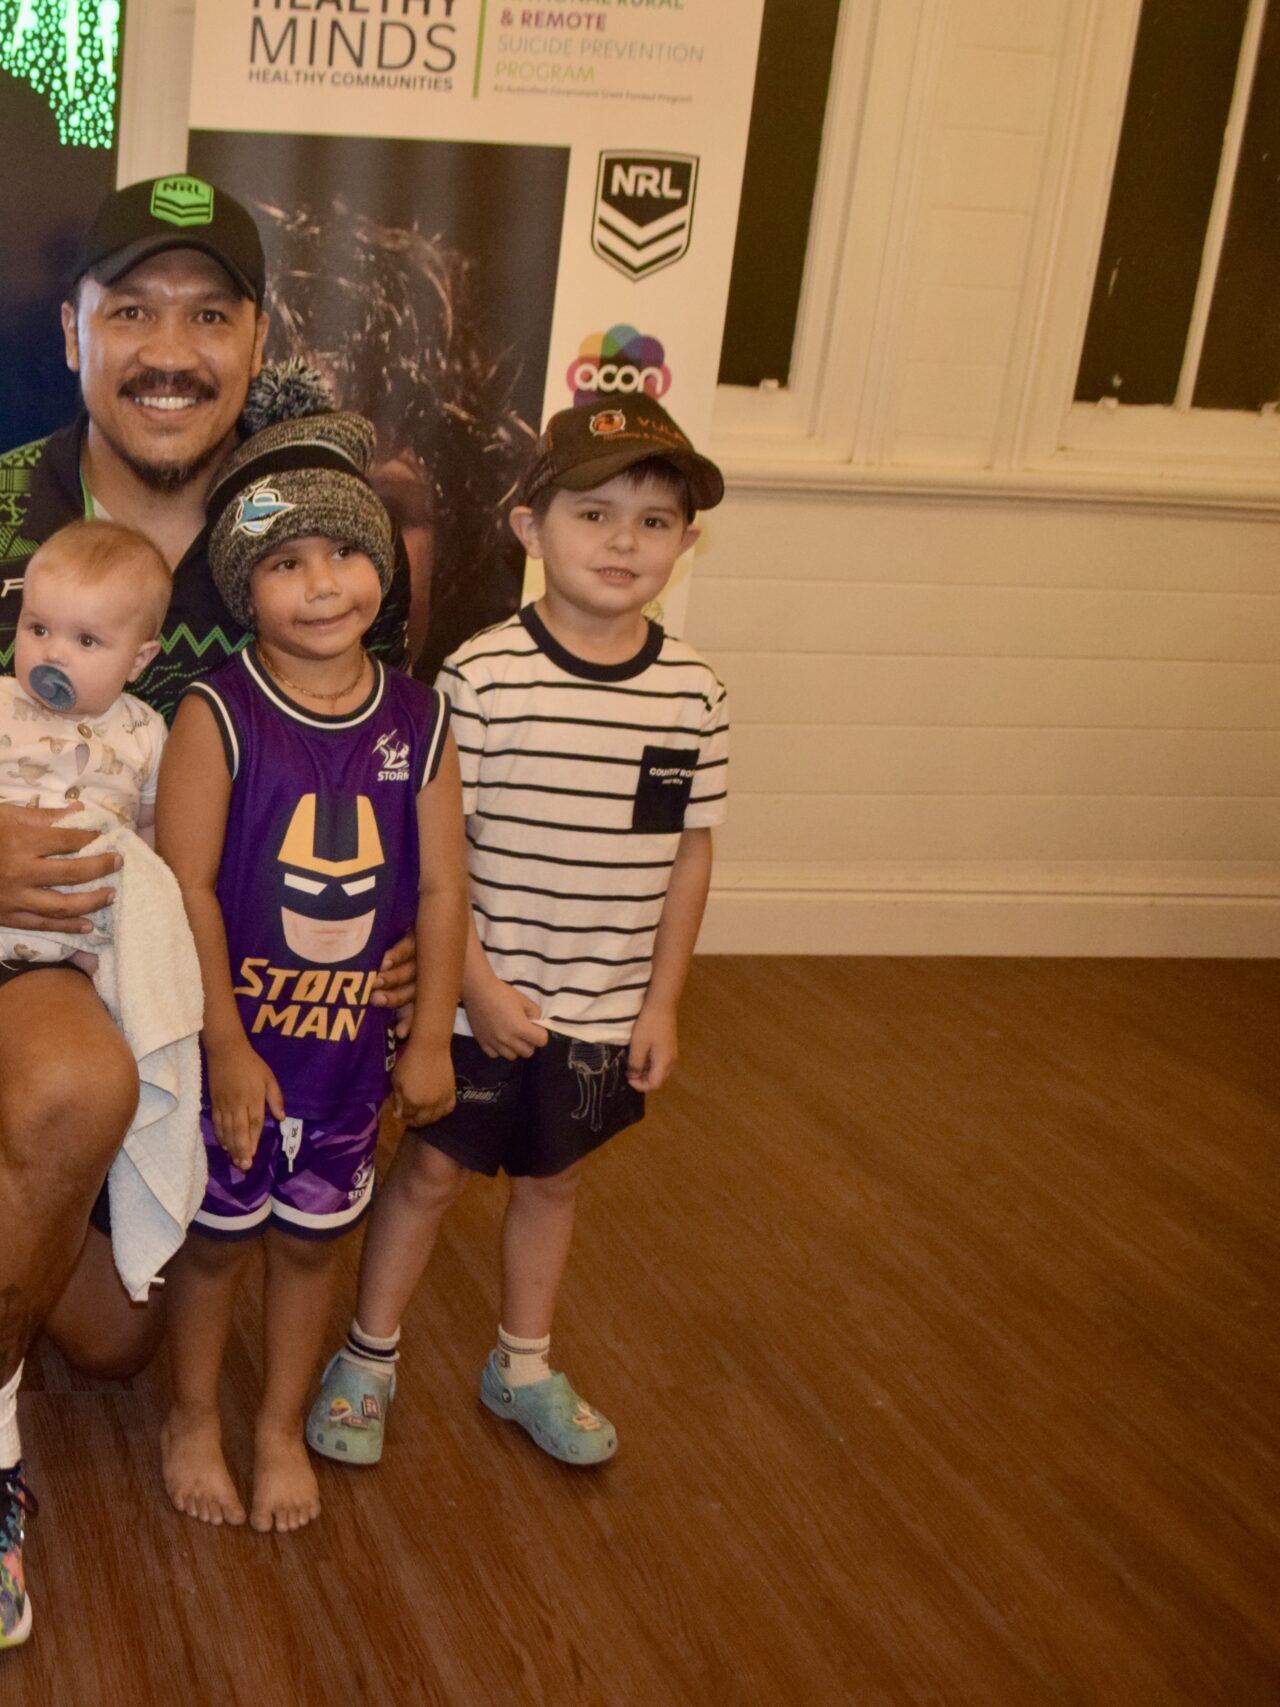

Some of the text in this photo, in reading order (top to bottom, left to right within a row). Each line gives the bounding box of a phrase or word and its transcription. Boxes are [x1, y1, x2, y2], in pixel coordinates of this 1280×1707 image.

[500, 8, 608, 31] & REMOTE
[250, 16, 457, 73] MINDS
[497, 35, 705, 63] SUICIDE PREVENTION
[248, 68, 454, 92] HEALTHY COMMUNITIES
[495, 61, 595, 81] PROGRAM
[163, 181, 205, 198] NRL
[611, 163, 683, 200] NRL
[574, 363, 664, 395] acon
[251, 1003, 366, 1042] MAN
